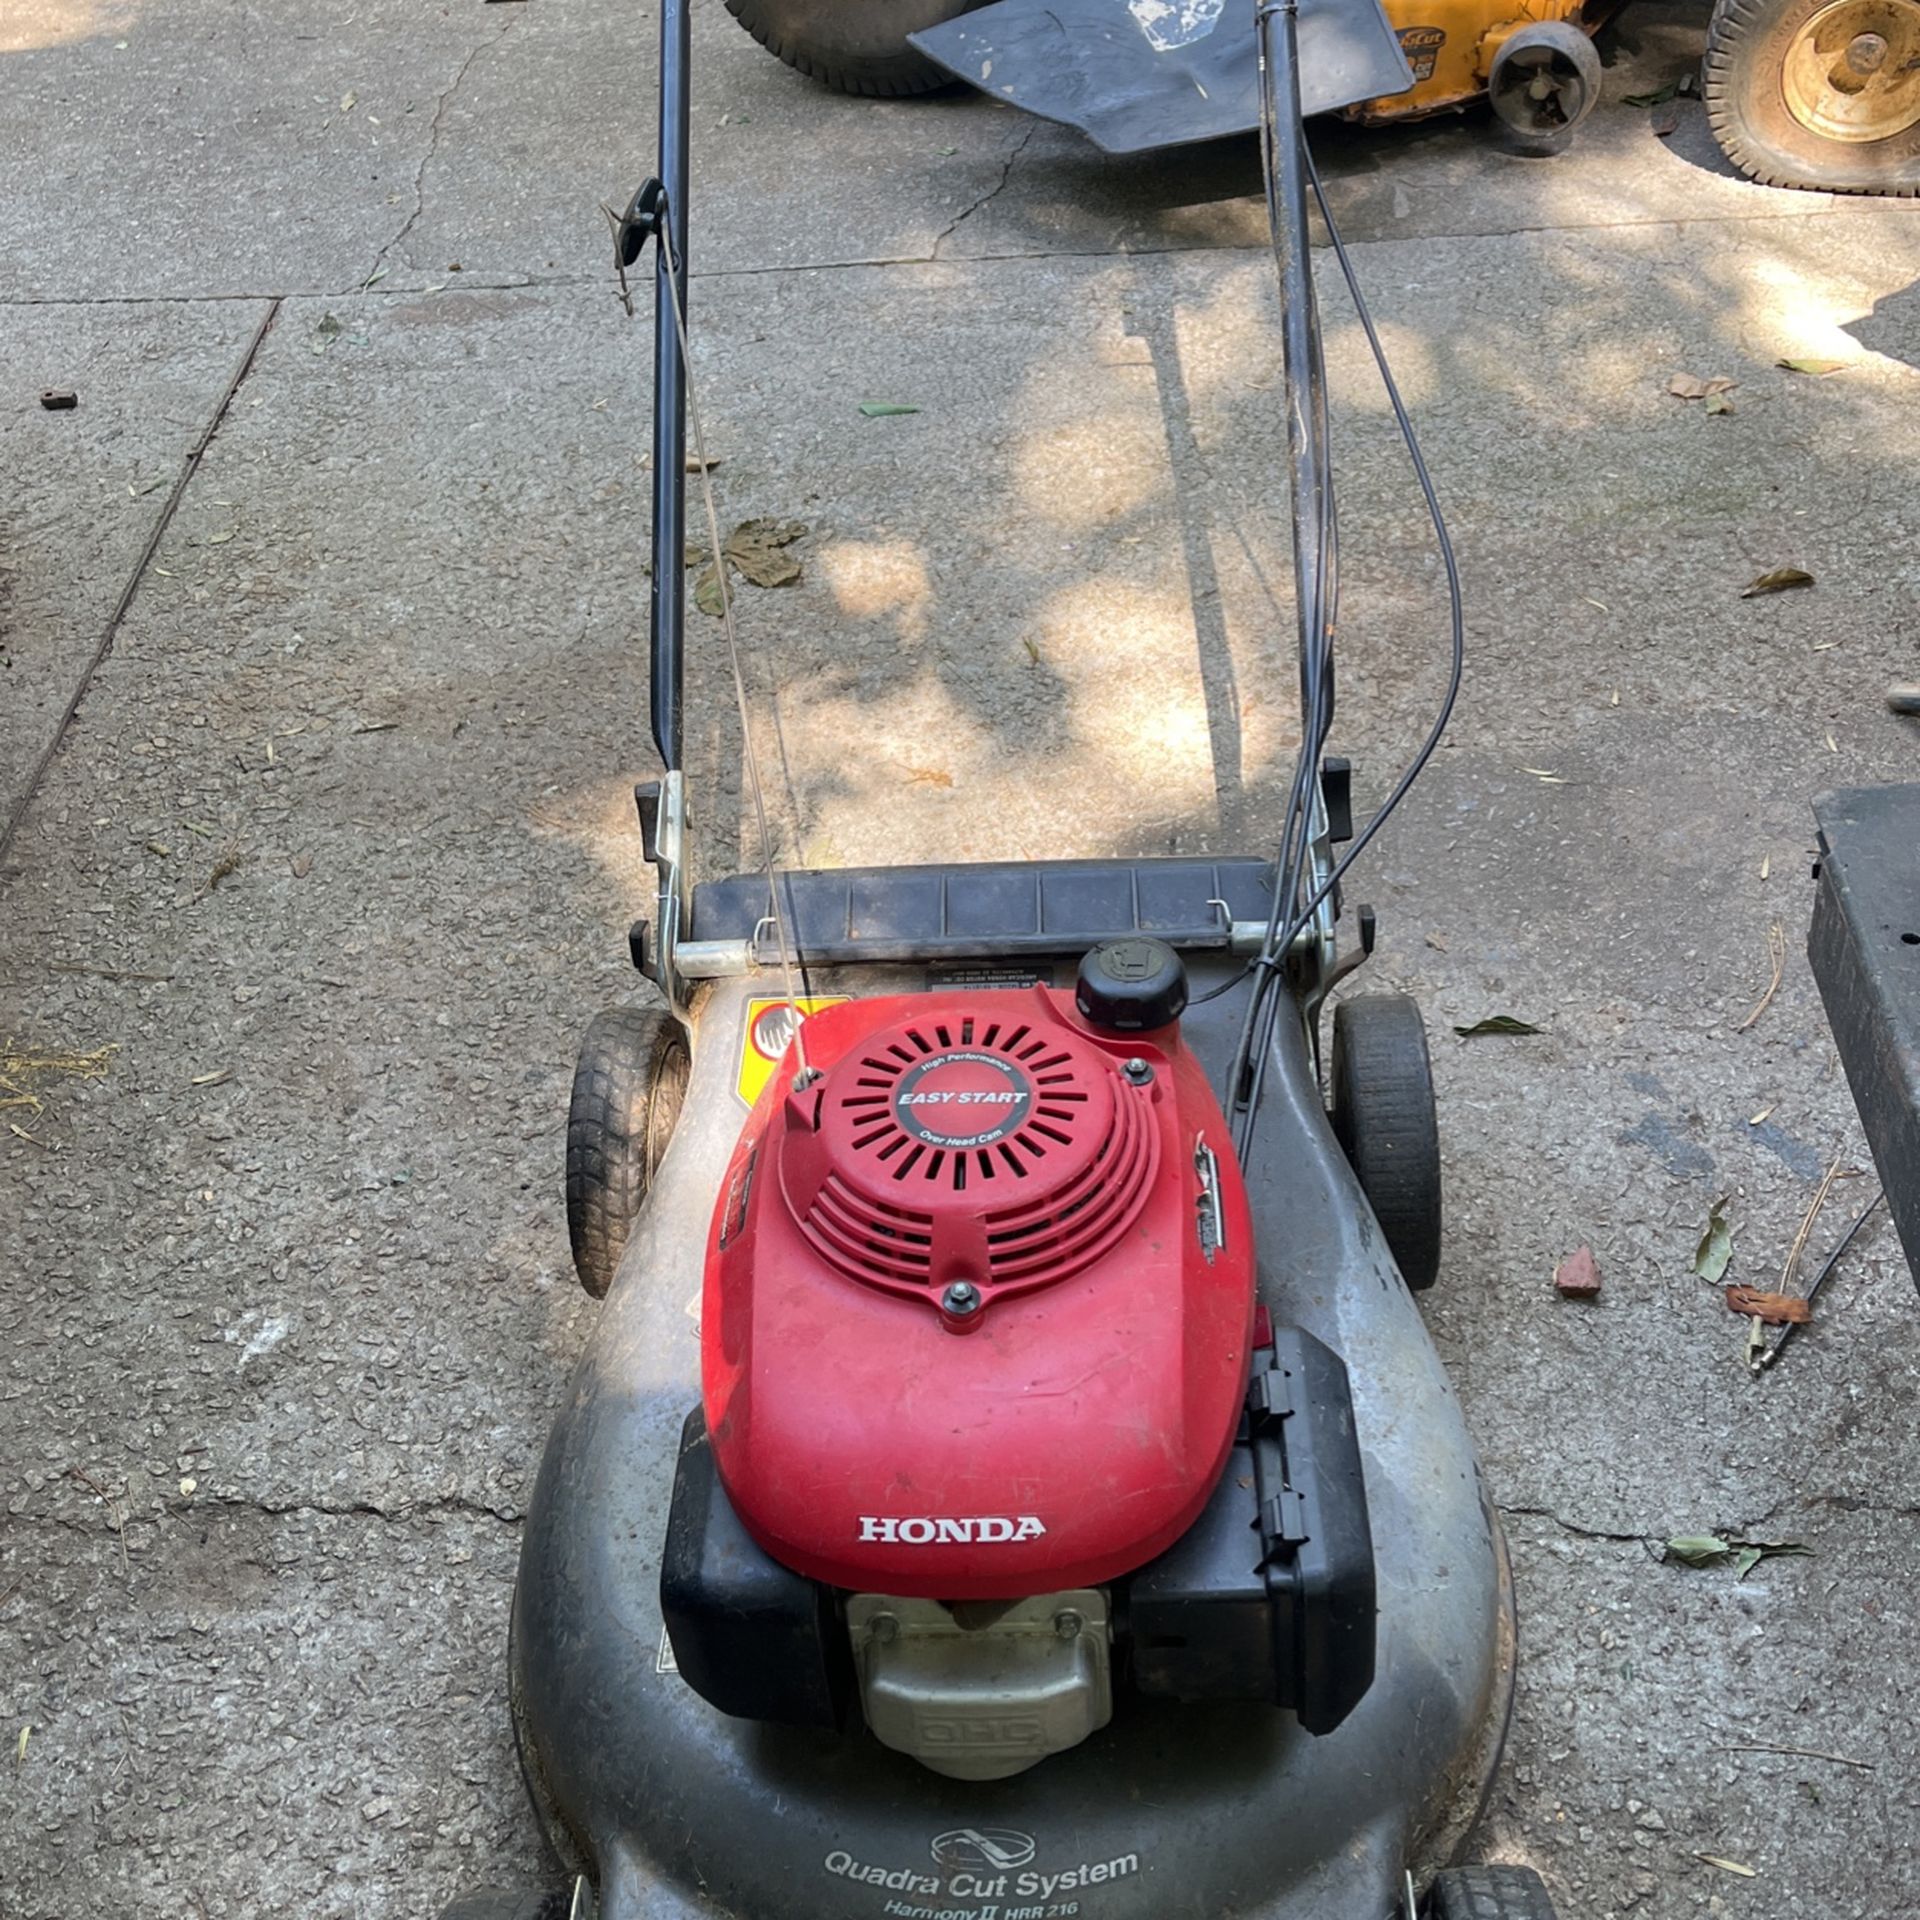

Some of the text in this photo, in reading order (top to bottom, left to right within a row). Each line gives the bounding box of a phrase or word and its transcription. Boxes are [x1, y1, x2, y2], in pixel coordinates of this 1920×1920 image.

[920, 1052, 1012, 1072] High Performance
[897, 1091, 1028, 1105] EASY START
[919, 1128, 1004, 1147] Over Head Cam
[858, 1515, 1046, 1544] HONDA
[824, 1850, 1138, 1900] Quadra Cut System
[883, 1899, 978, 1920] Harmony
[1003, 1905, 1045, 1920] HRR
[1046, 1901, 1079, 1917] 216
